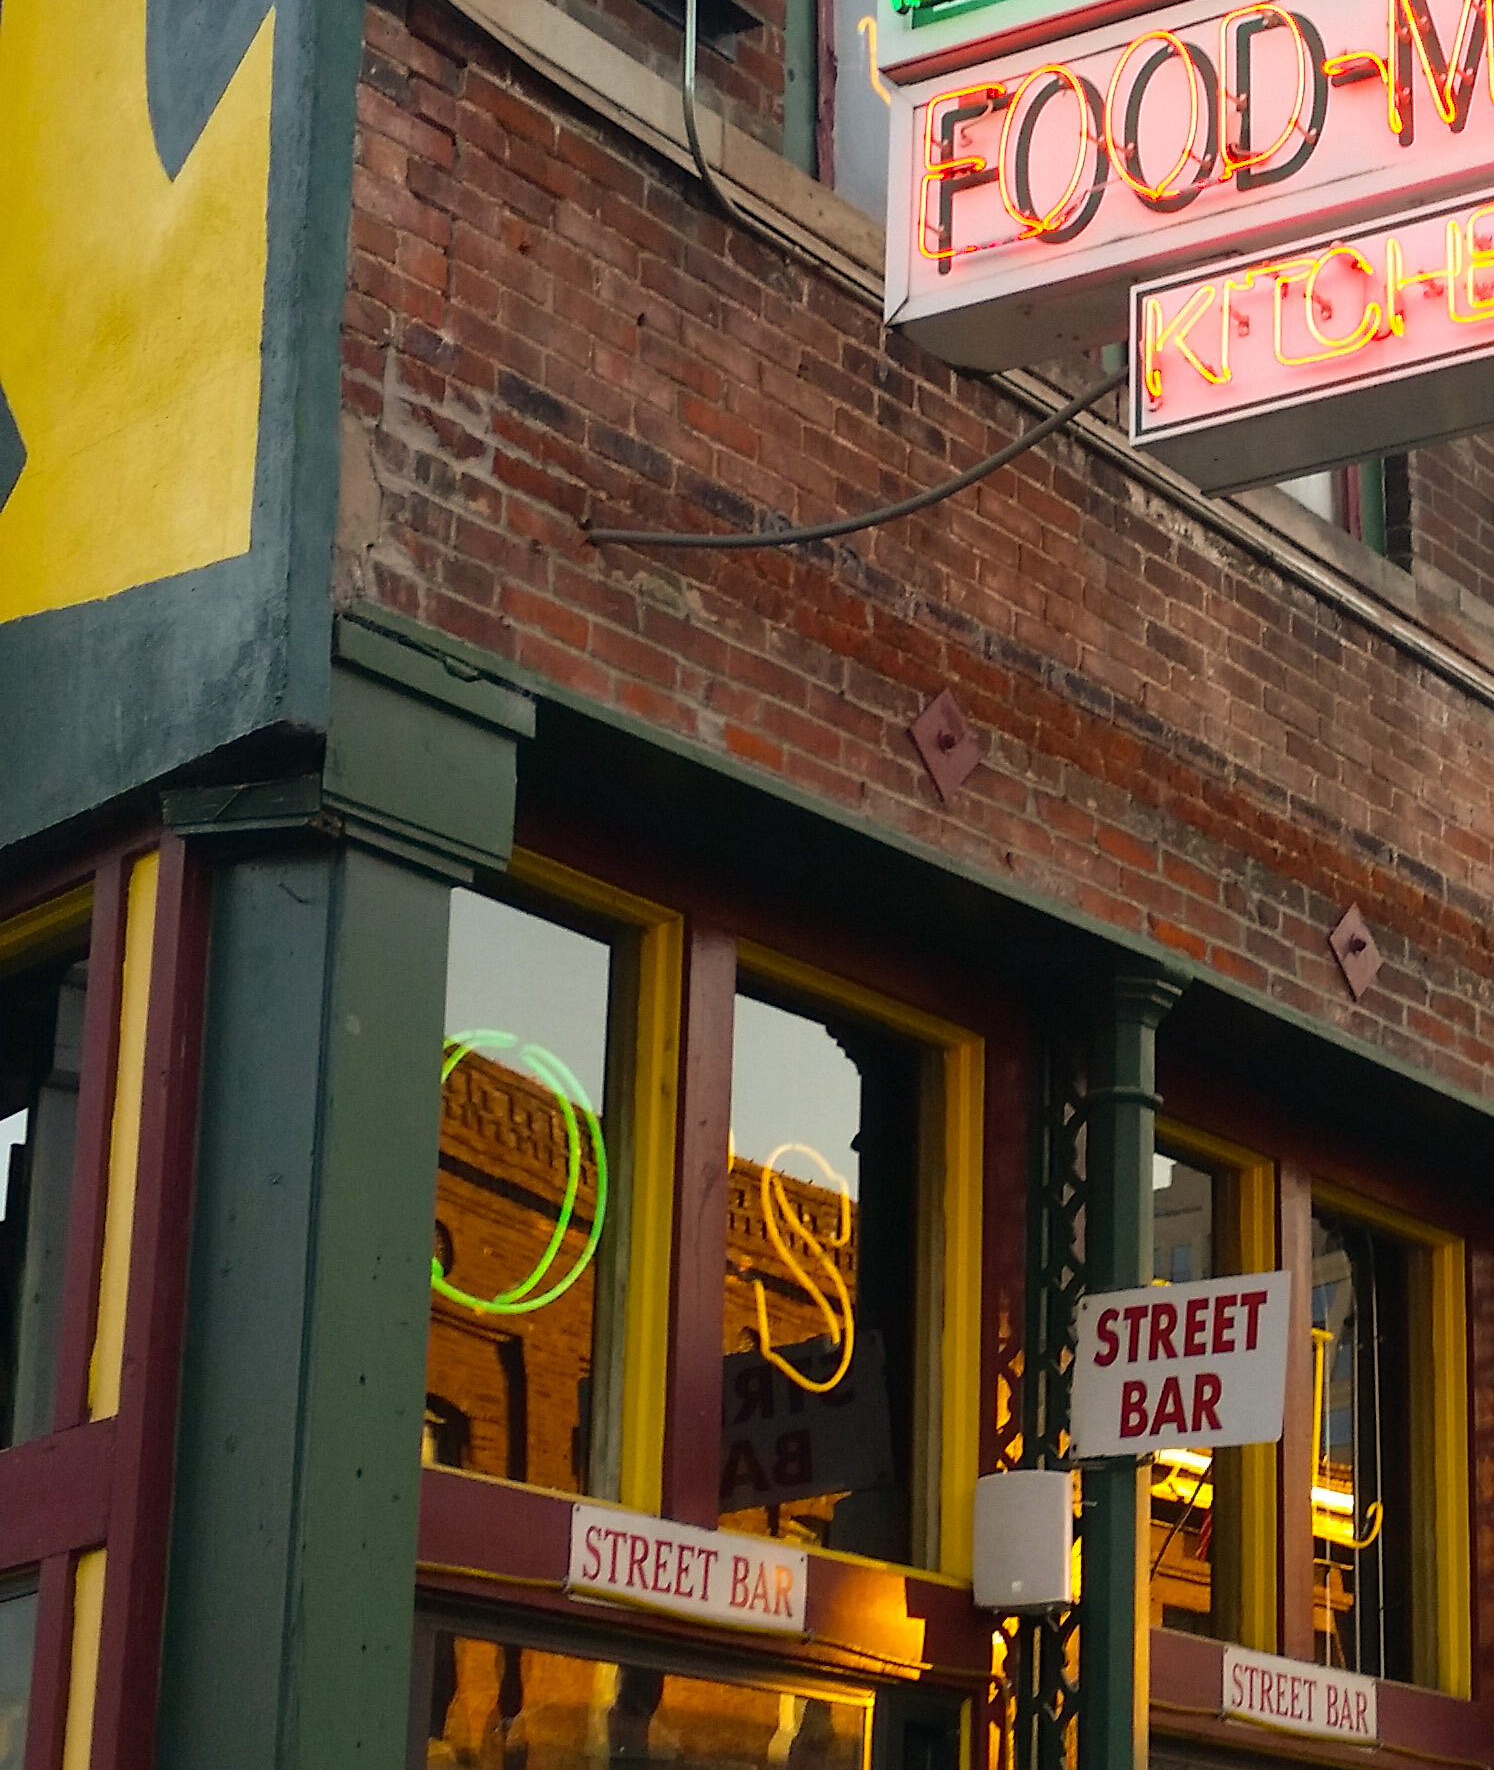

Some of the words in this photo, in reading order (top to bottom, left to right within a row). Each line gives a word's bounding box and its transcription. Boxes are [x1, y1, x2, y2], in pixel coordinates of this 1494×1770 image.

[1093, 1290, 1268, 1367] STREET
[1119, 1374, 1223, 1439] BAR
[581, 1525, 718, 1605] STREET
[729, 1554, 795, 1619] BAR
[1230, 1662, 1317, 1723] STREET
[1326, 1690, 1369, 1735] BAR
